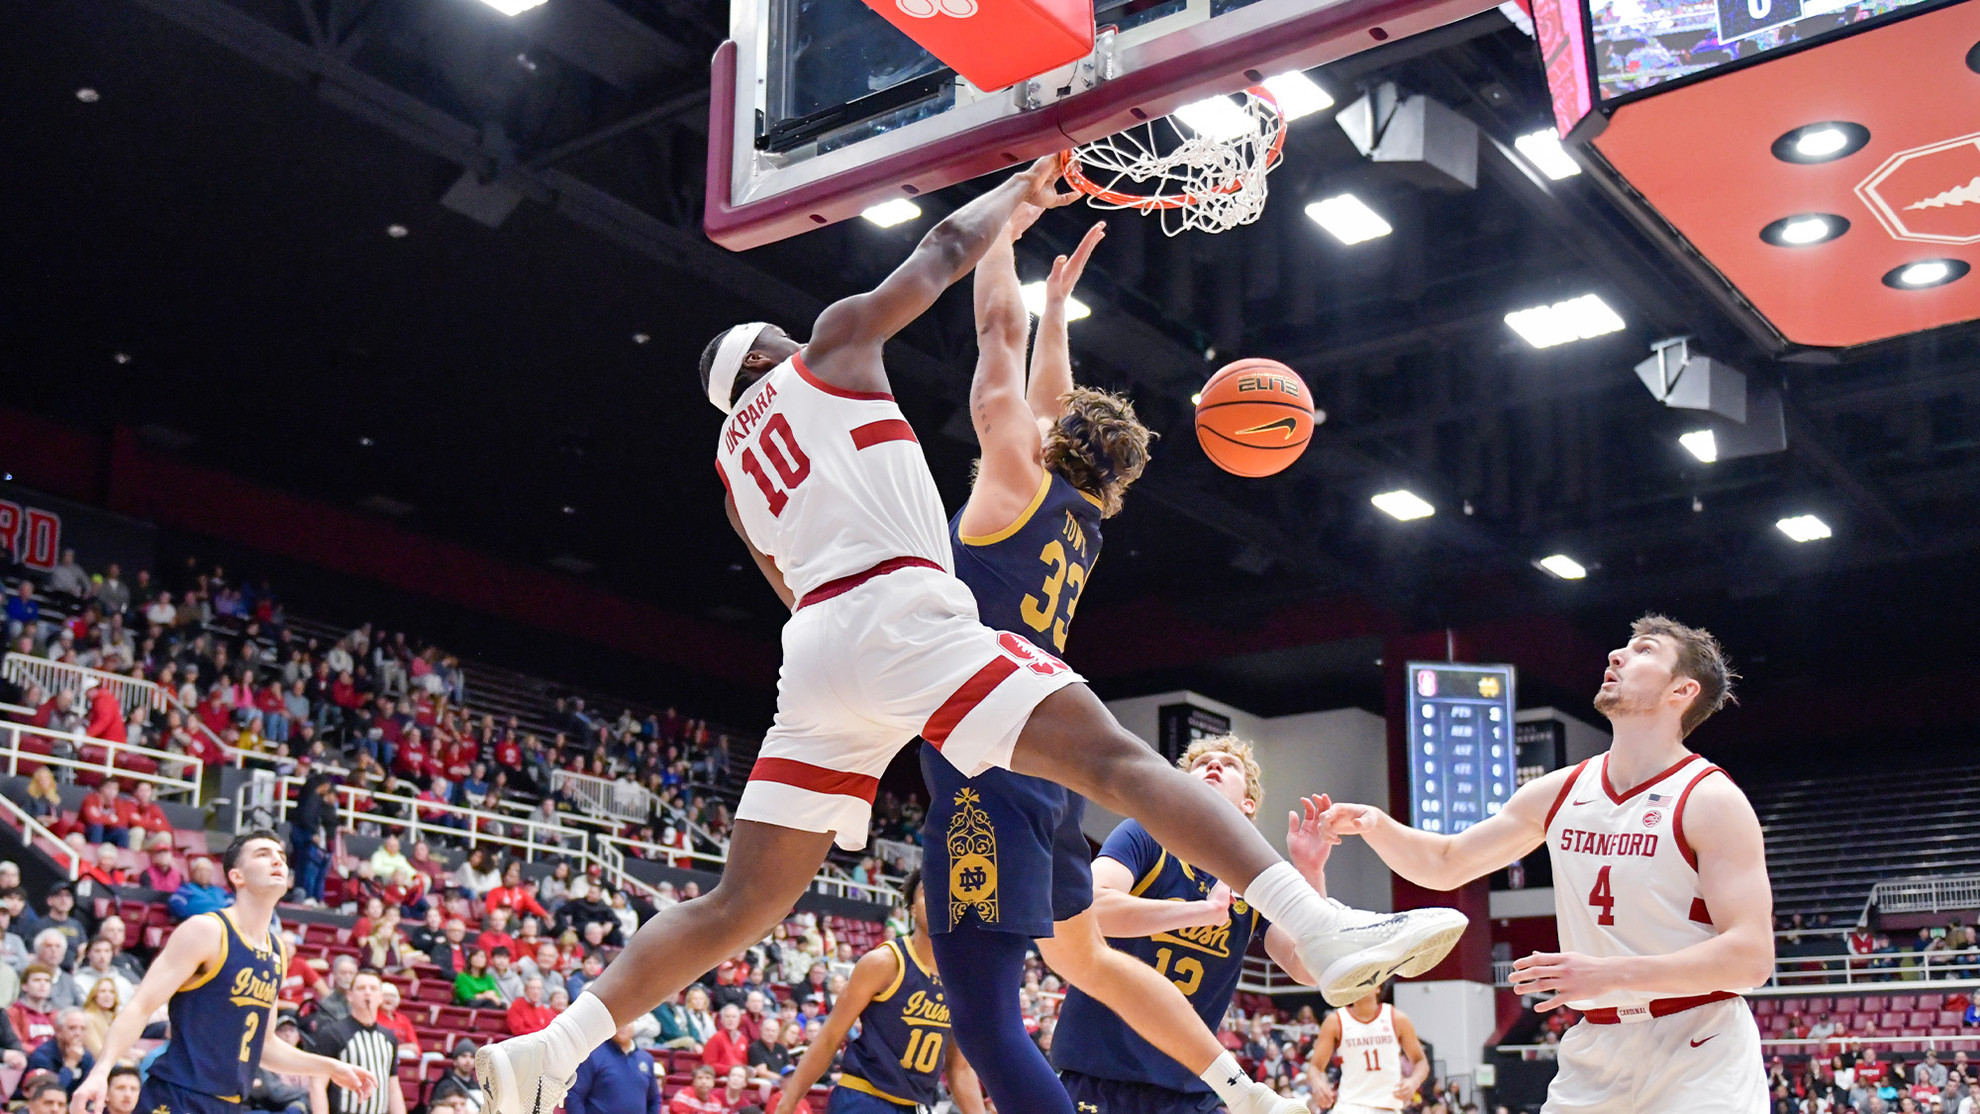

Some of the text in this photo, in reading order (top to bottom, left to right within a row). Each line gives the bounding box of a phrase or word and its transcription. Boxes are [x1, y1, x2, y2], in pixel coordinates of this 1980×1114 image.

[1238, 376, 1299, 398] ELITE
[725, 381, 778, 455] OKPARA
[741, 412, 811, 518] 10
[1019, 539, 1085, 654] 33
[1561, 828, 1658, 858] STANFORD
[1589, 865, 1614, 926] 4
[1619, 1007, 1647, 1016] CARDINAL
[239, 1011, 259, 1062] 2
[900, 1028, 943, 1073] 10
[1345, 1034, 1393, 1048] STANFORD
[1364, 1048, 1381, 1071] 11
